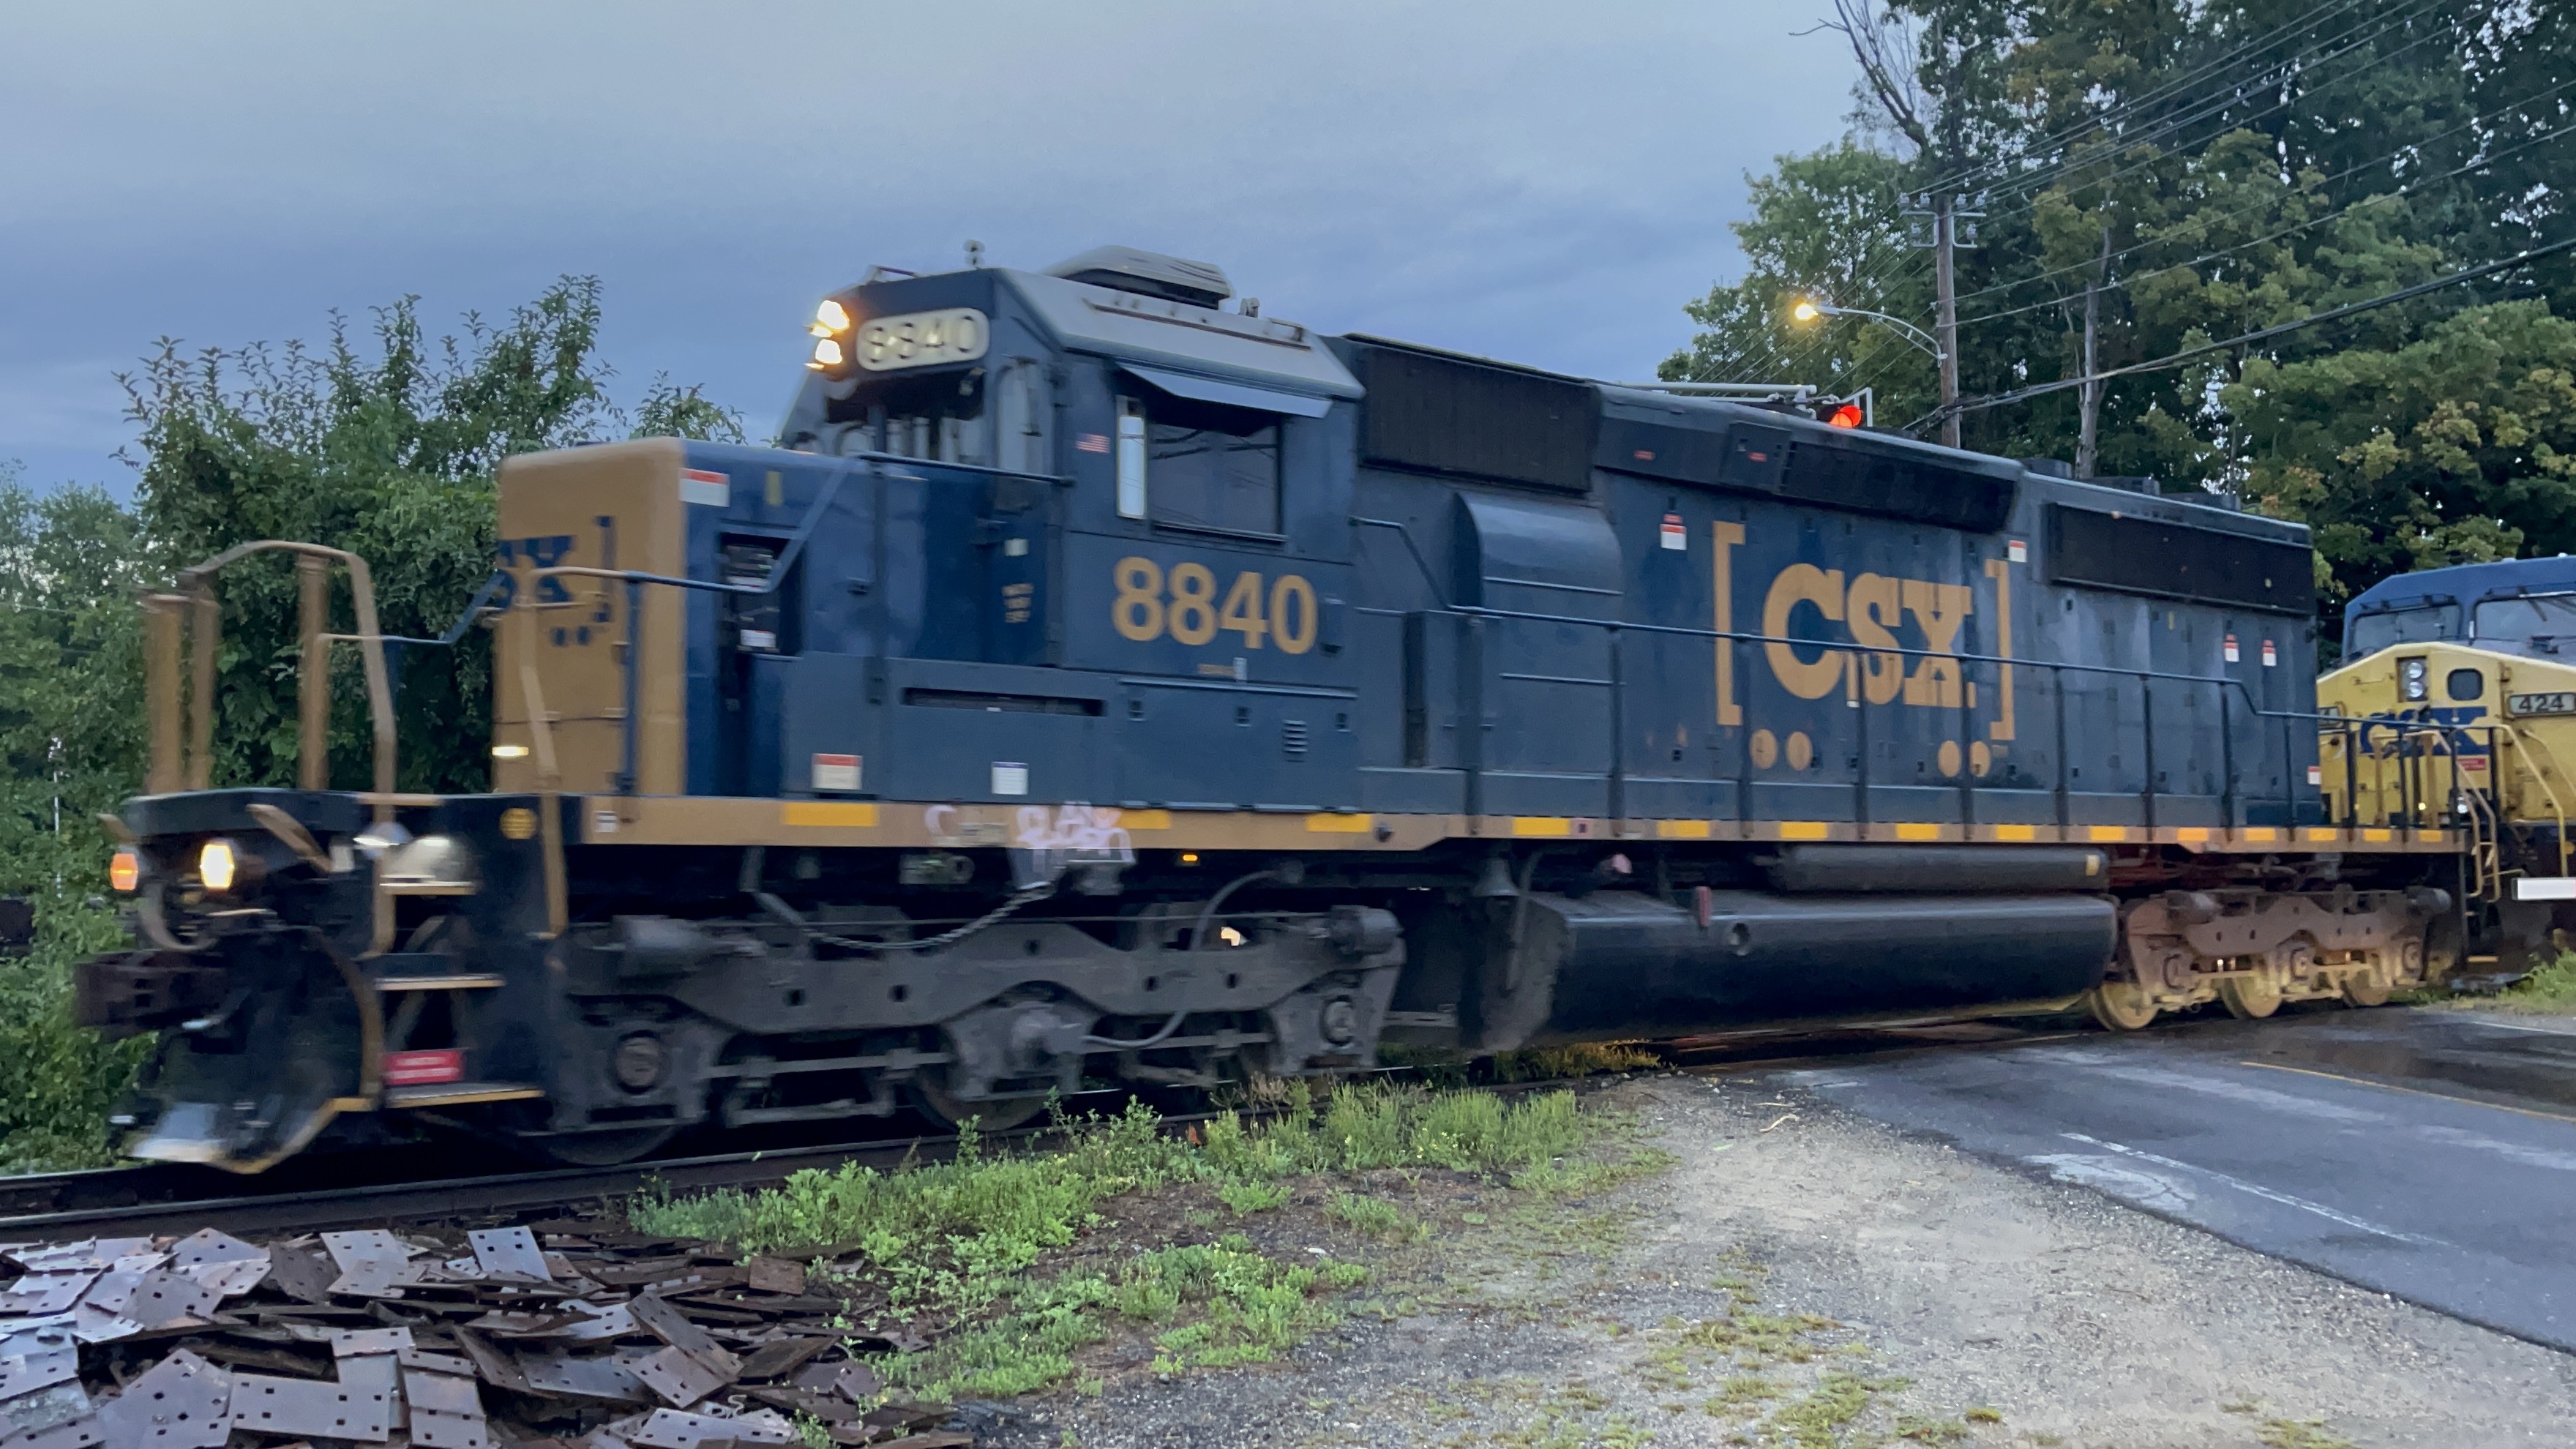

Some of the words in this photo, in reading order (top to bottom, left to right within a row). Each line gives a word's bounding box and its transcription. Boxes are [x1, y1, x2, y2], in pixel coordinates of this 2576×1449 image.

[865, 315, 976, 364] 8840
[1112, 556, 1317, 654] 8840
[2518, 694, 2564, 713] 424
